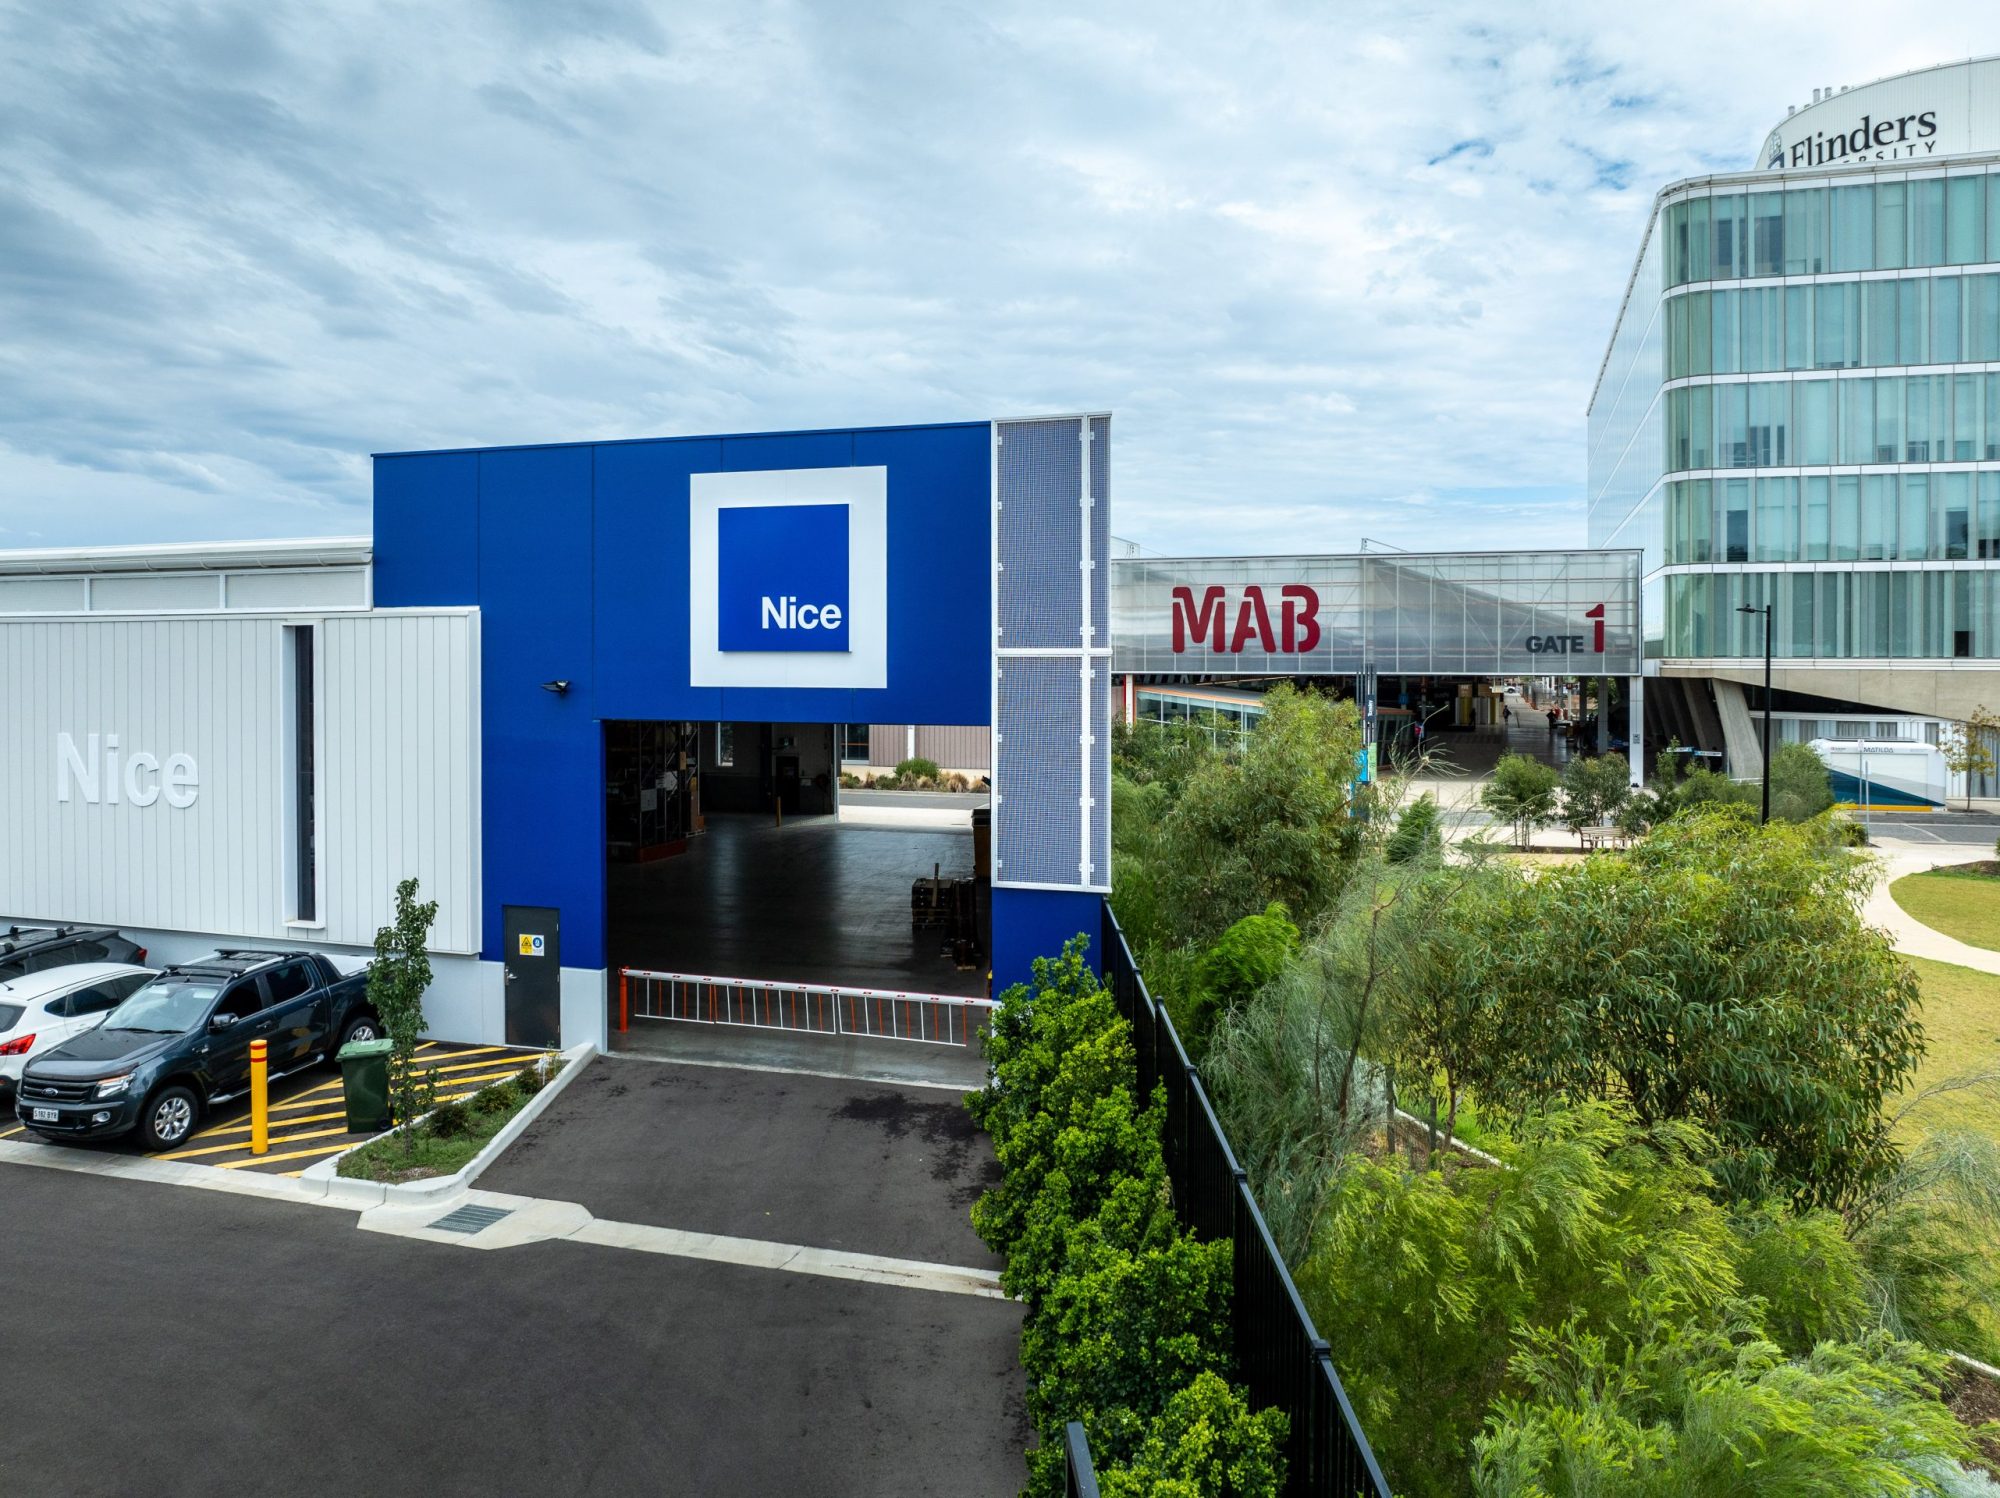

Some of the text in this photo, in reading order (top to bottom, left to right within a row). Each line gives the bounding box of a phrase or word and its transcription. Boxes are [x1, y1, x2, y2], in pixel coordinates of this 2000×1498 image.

[1790, 111, 1937, 166] Flinders
[762, 597, 842, 629] Nice
[1173, 586, 1320, 653] MAB
[1526, 603, 1604, 654] GATE 1
[57, 732, 199, 808] Nice
